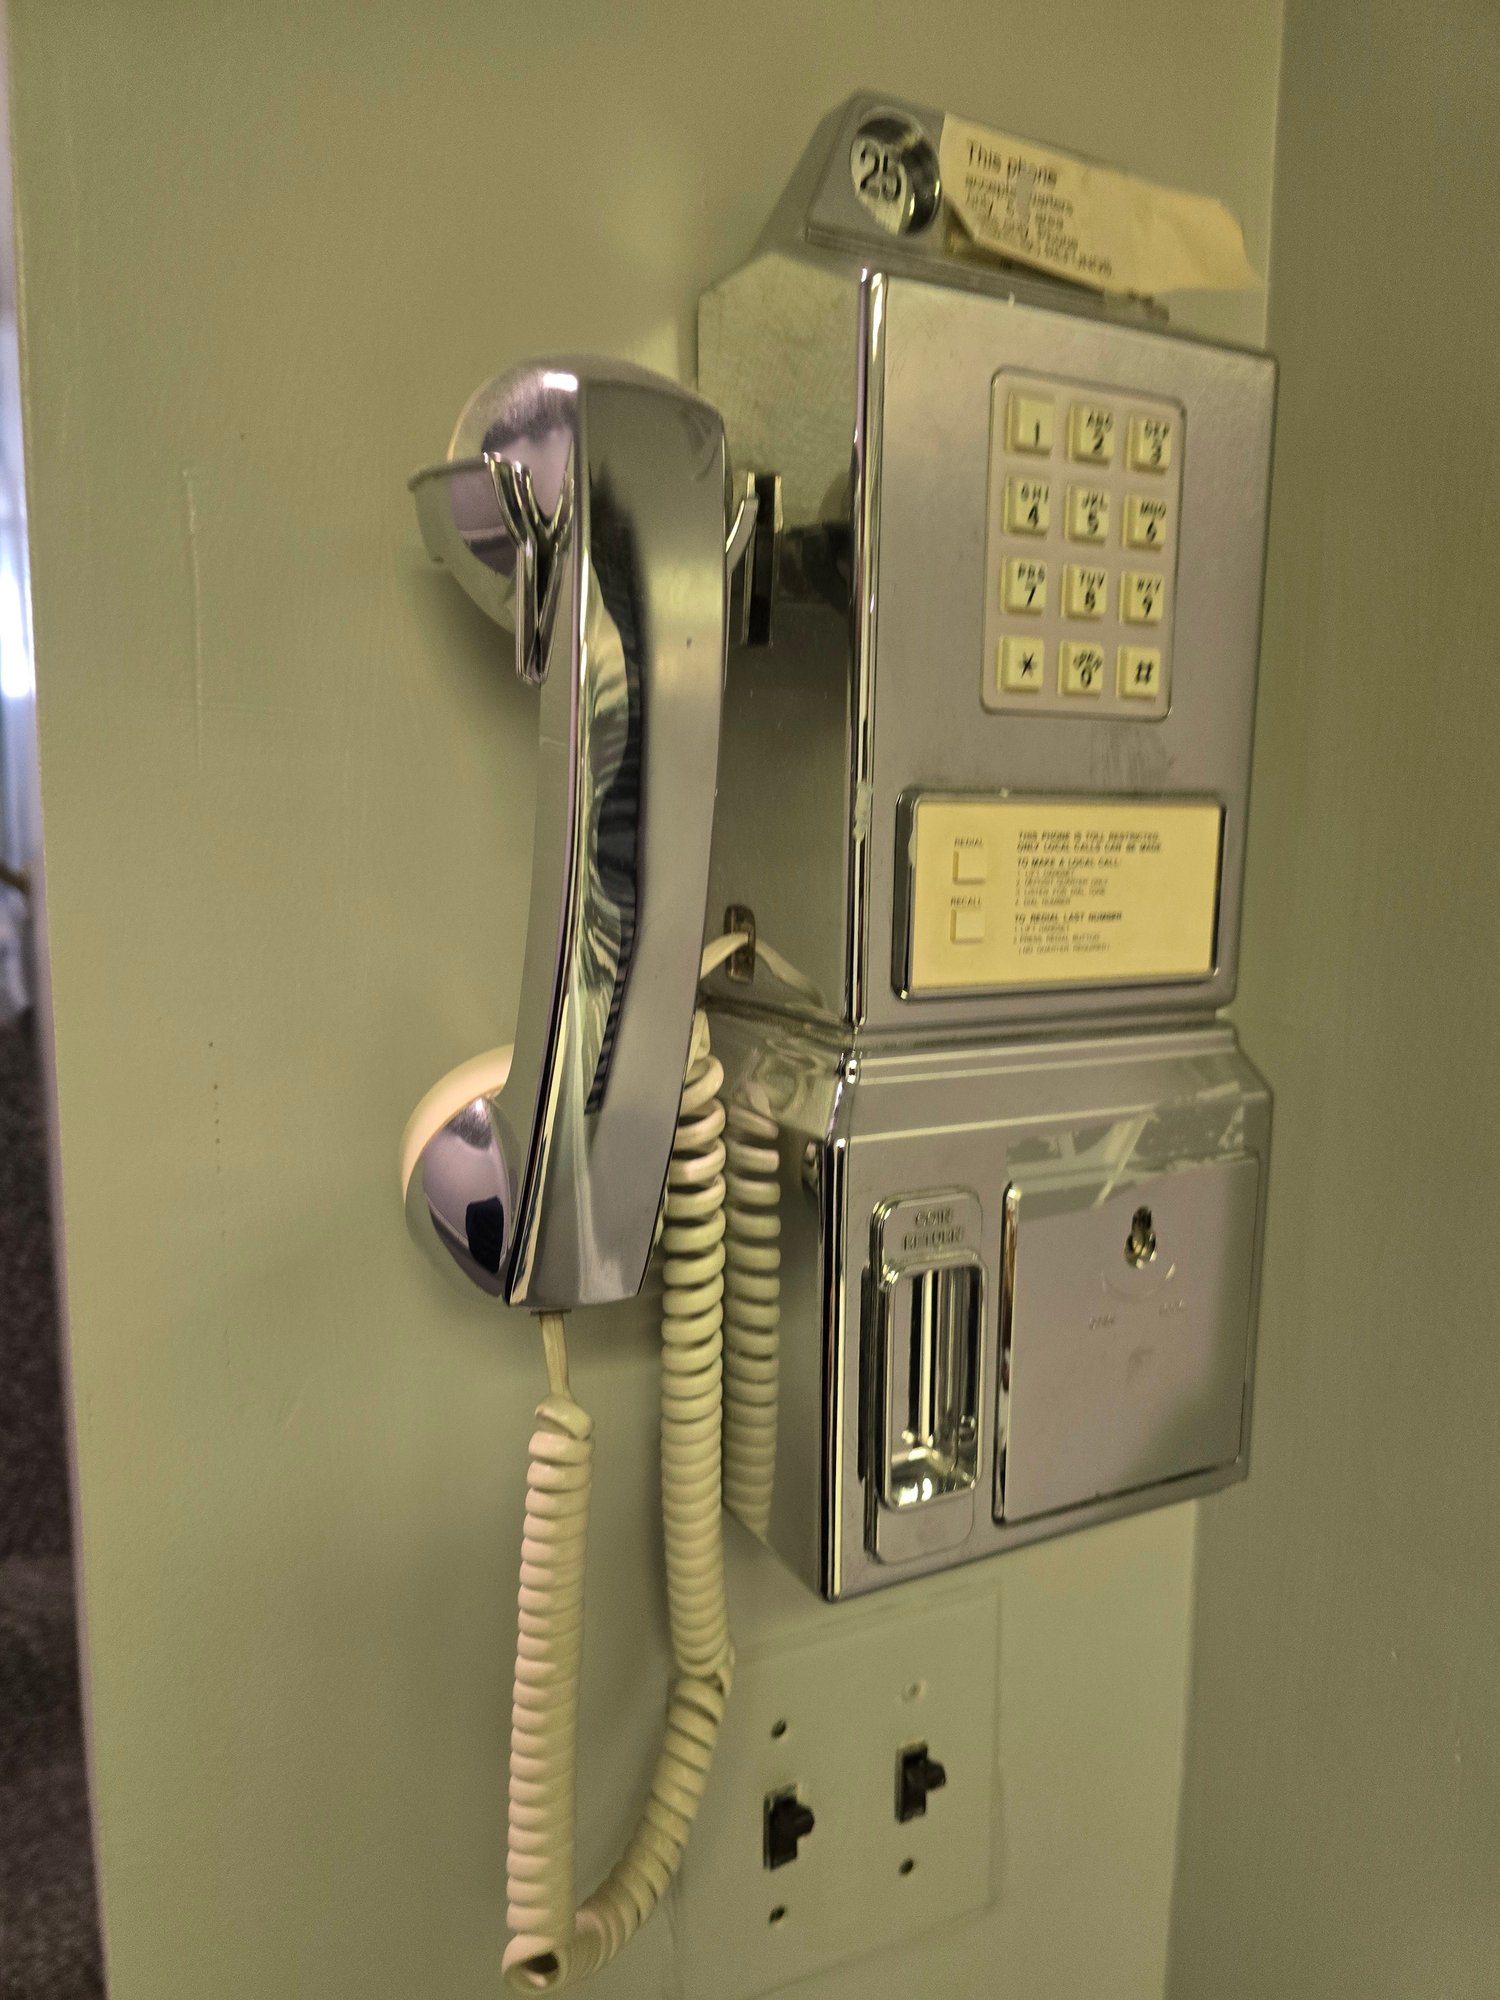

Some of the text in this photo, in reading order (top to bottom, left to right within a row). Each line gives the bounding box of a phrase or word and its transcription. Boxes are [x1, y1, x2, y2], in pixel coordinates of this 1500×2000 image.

[967, 138, 1001, 174] This
[860, 139, 903, 201] 25
[1034, 418, 1041, 448] 1
[1093, 427, 1105, 455] 2
[1152, 439, 1162, 464] 3
[1021, 483, 1050, 504] GHI
[1027, 503, 1040, 527] 4
[1088, 511, 1099, 535] 5
[1146, 518, 1157, 542] 6
[1080, 570, 1105, 589] TUV
[1025, 581, 1037, 608] 7
[1084, 588, 1096, 612] 8
[1142, 595, 1153, 617] 9
[1135, 659, 1154, 685] #
[954, 836, 984, 849] REDIAL
[1019, 831, 1038, 841] THIS
[1041, 831, 1070, 841] PHONE
[1043, 843, 1069, 853] LOCAL
[1073, 843, 1101, 853] CALLS
[1104, 843, 1121, 853] CAN
[1018, 857, 1028, 868] TO
[1031, 857, 1055, 868] MAKE
[1068, 857, 1094, 868] LOCAL
[950, 896, 981, 908] RECALL
[1015, 911, 1122, 923] TO REDIAL LAST NUMBER
[915, 1208, 952, 1226] COIN
[904, 1226, 962, 1251] RETURN
